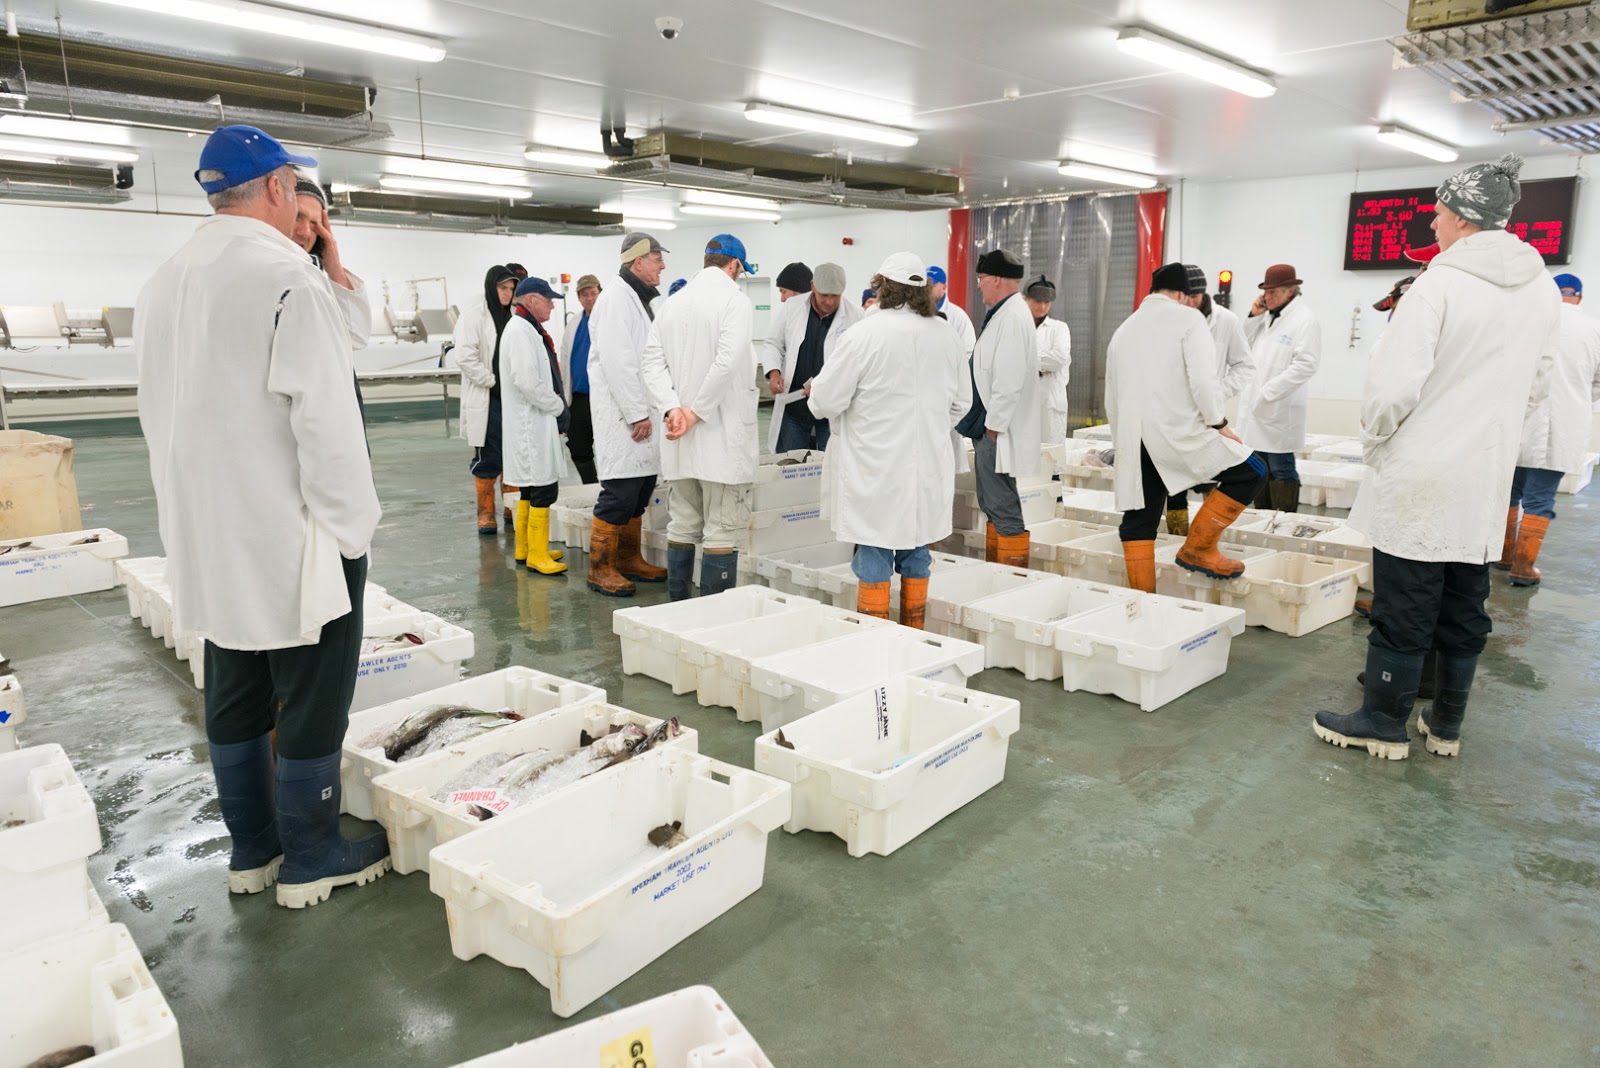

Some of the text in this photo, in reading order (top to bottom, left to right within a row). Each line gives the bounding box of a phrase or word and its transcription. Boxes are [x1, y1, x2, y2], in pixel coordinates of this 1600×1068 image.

[357, 653, 412, 668] RAWLER AGENTS
[357, 669, 369, 677] USE
[373, 665, 391, 674] ONLY
[880, 686, 888, 712] LIZZY
[453, 790, 497, 803] CHANNEL
[631, 871, 662, 895] BRIXHAM
[664, 851, 694, 874] TRAWLER
[696, 838, 721, 856] AGENTS
[653, 861, 711, 902] MARKET USE ONLY
